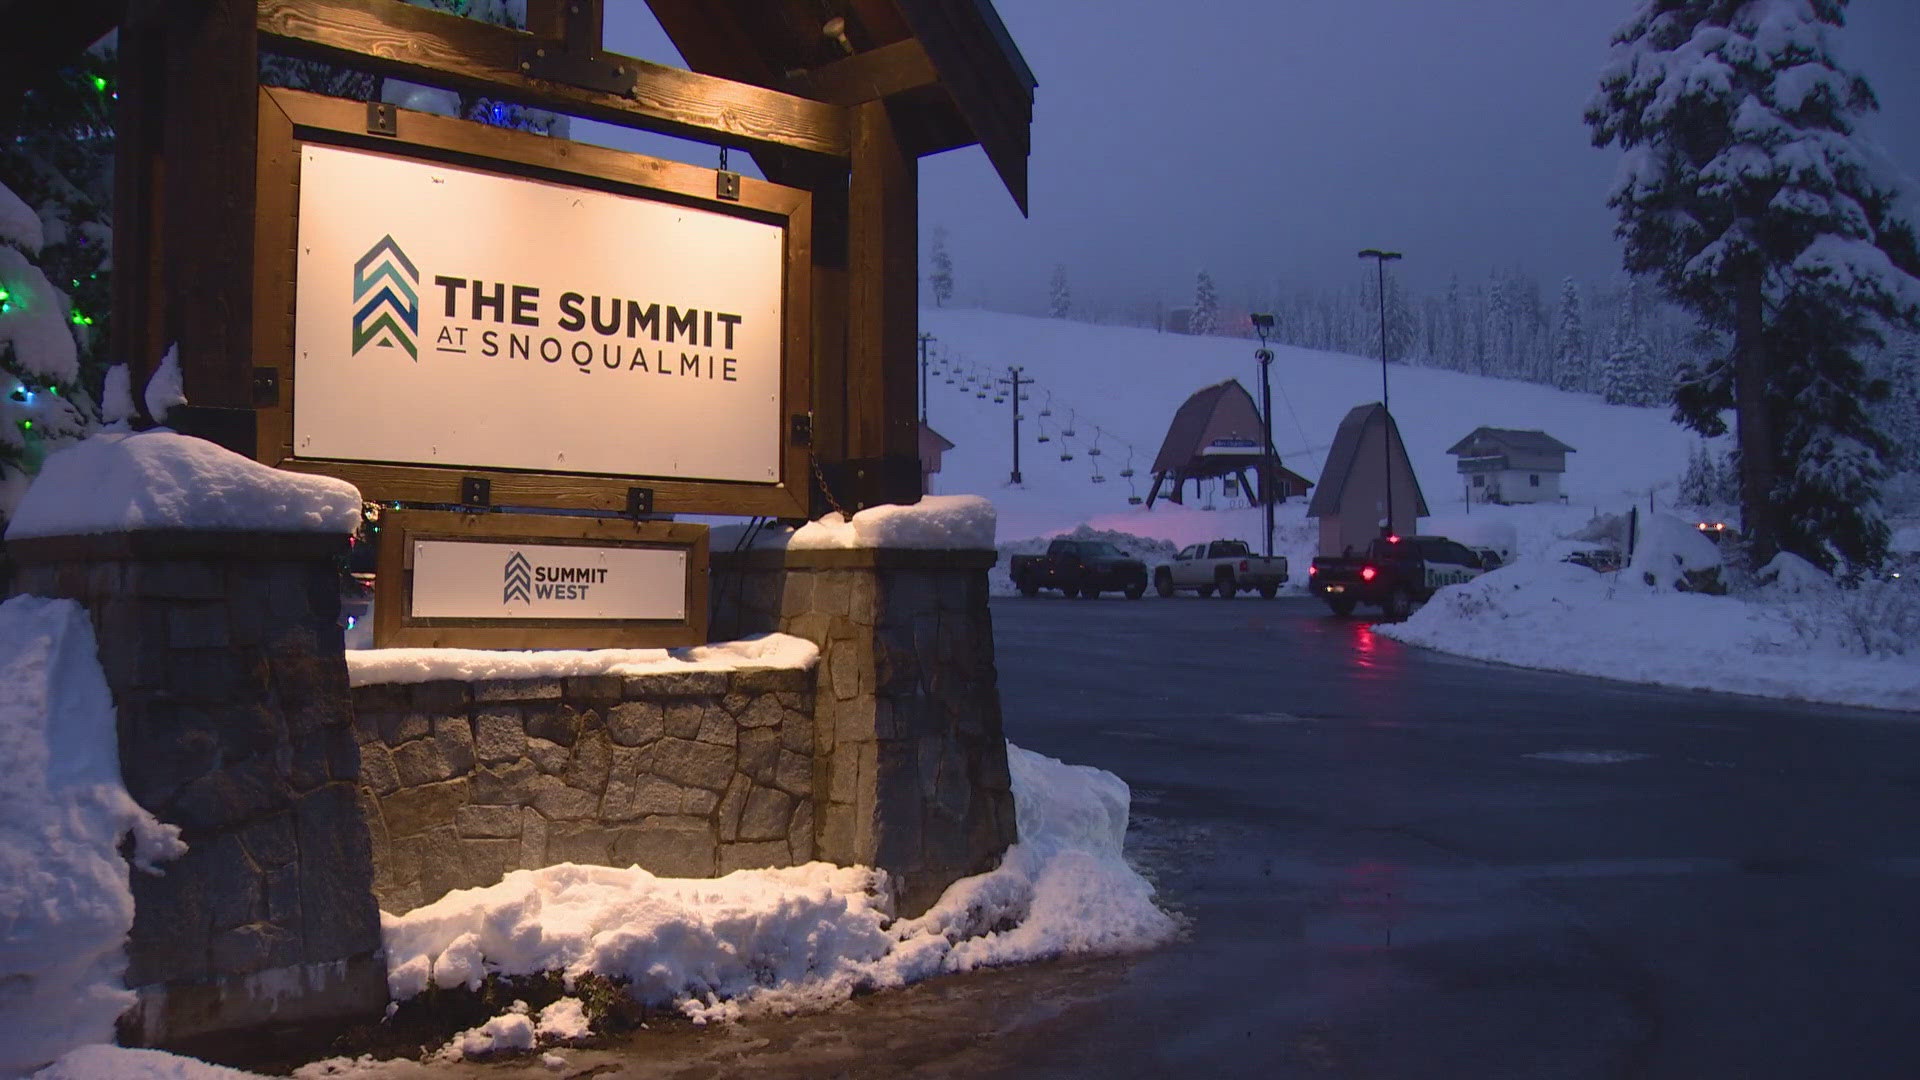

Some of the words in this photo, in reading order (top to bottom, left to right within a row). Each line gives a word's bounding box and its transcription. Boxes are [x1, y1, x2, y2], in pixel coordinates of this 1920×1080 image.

[434, 274, 540, 328] THE
[557, 291, 742, 351] SUMMIT
[436, 325, 469, 347] AT
[481, 330, 738, 382] SNOQUALMIE
[534, 566, 608, 584] SUMMIT
[534, 583, 590, 600] WEST
